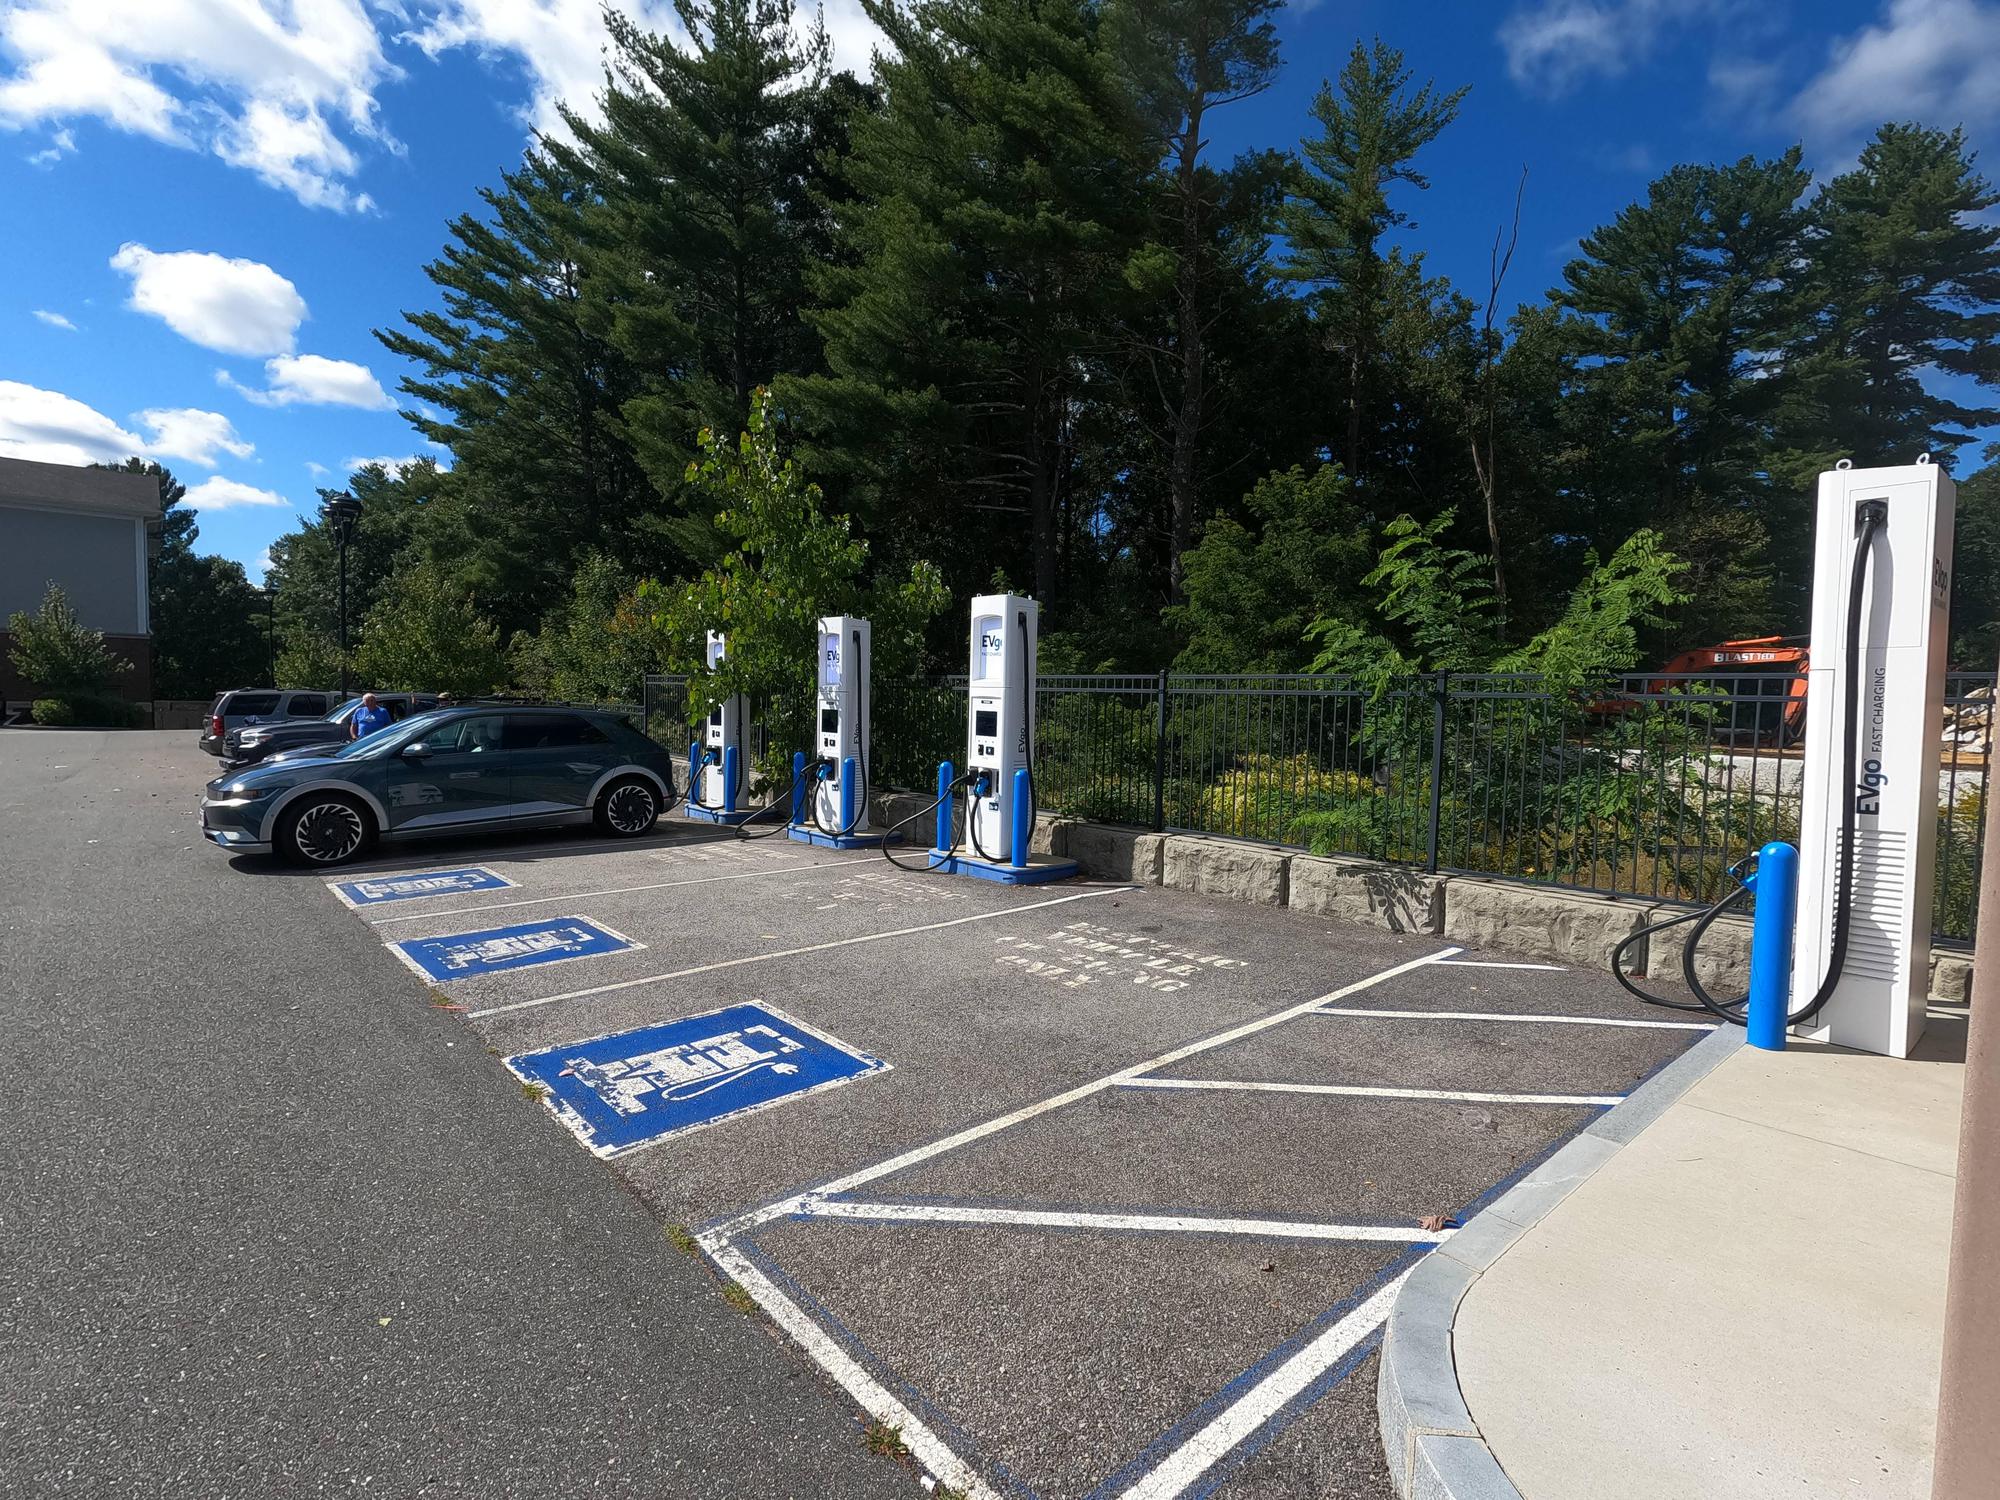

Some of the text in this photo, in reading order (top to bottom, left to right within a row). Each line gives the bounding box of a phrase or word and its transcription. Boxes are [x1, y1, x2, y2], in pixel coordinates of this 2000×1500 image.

[827, 650, 840, 663] EVg
[1713, 652, 1755, 663] BLAST
[1856, 667, 1889, 816] EVgo FAST CHARGING
